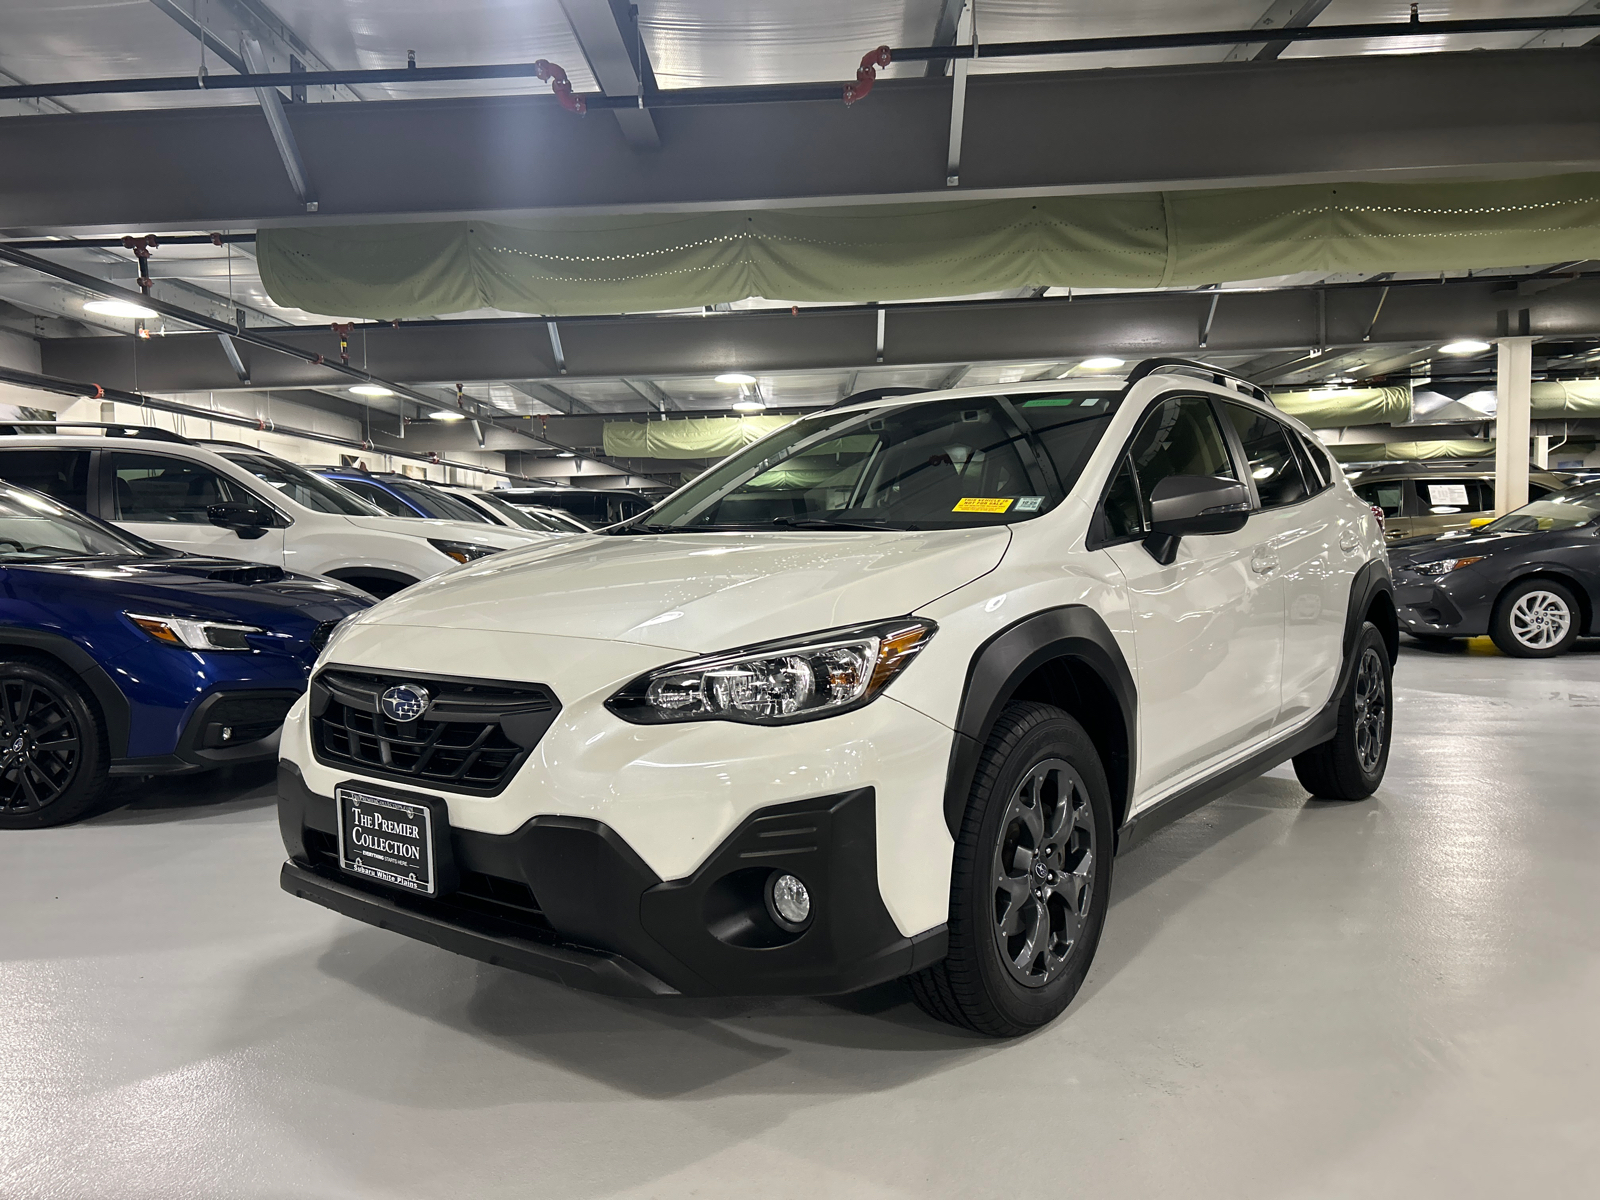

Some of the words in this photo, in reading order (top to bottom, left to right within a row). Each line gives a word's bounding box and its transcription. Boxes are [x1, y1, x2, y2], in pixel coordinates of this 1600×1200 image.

[351, 807, 374, 829] THE
[373, 812, 420, 839] PREMIER
[352, 826, 420, 860] COLLECTION
[362, 850, 385, 861] EVERYTHING
[384, 856, 398, 864] STARTS
[353, 864, 375, 876] Subaru
[376, 870, 395, 882] White
[397, 876, 418, 889] Plains
